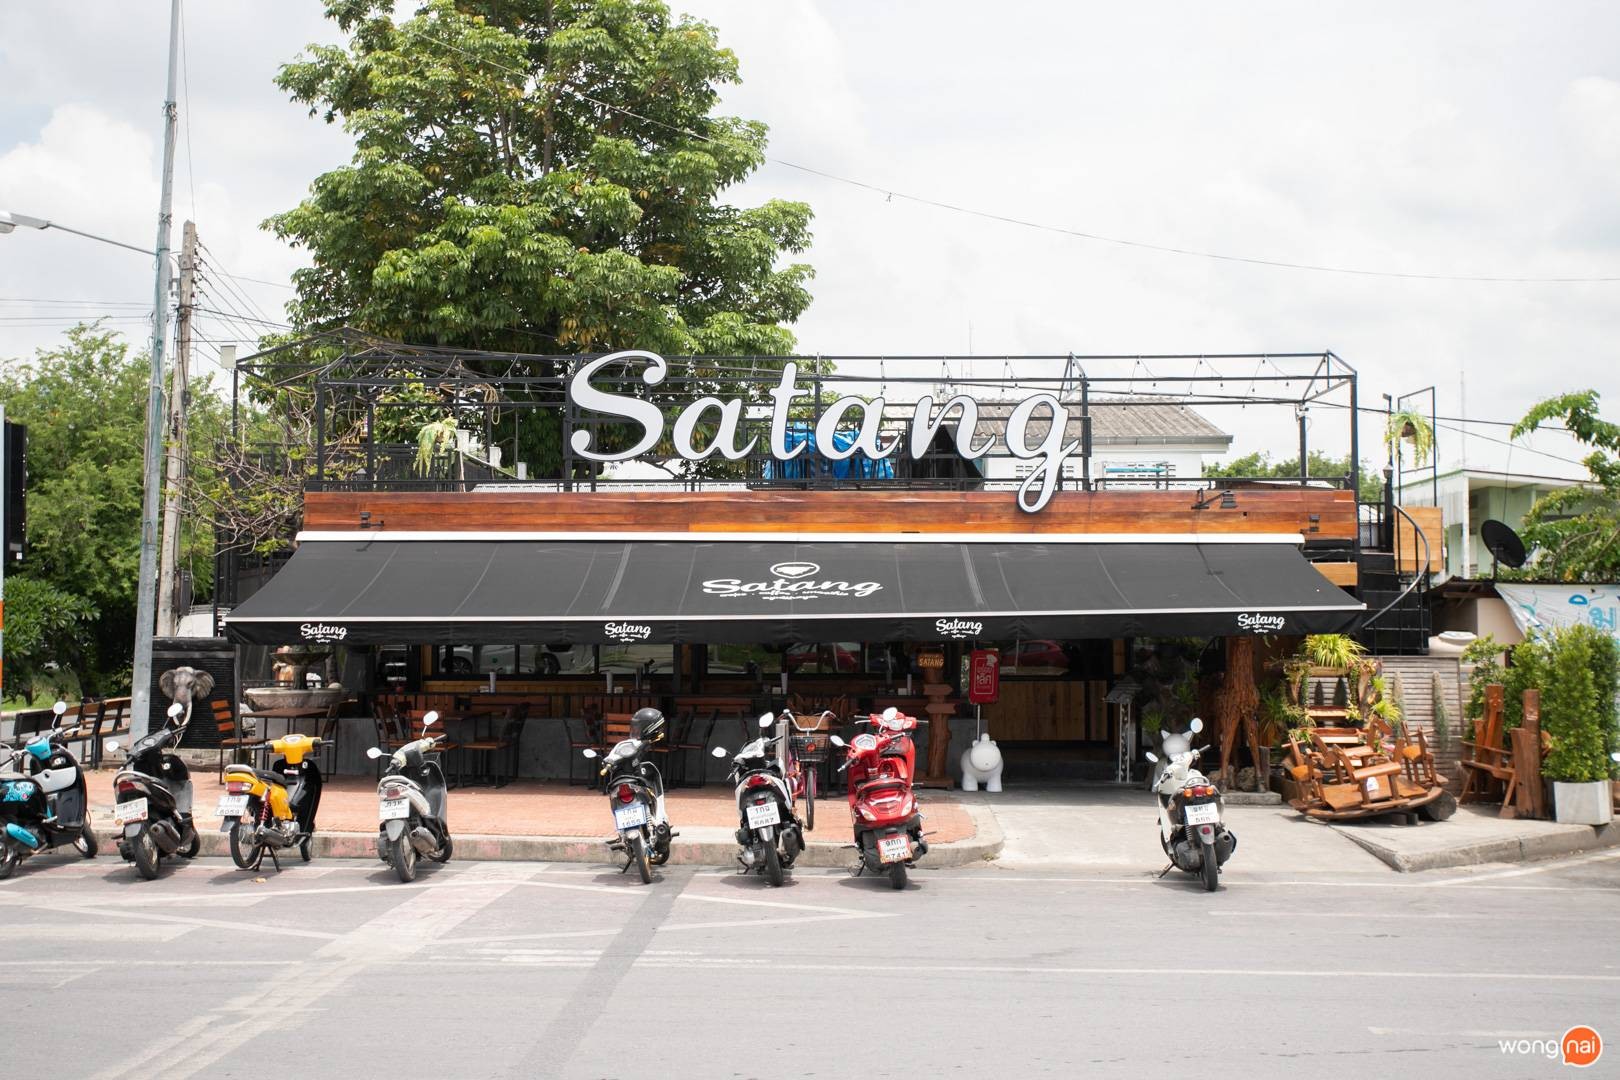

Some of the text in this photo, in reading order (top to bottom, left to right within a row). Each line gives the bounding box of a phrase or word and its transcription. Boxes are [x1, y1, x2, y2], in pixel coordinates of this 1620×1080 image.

[570, 350, 1080, 513] Satang
[702, 578, 884, 597] Satang
[604, 621, 652, 639] Satang
[935, 618, 983, 635] Satang
[1237, 613, 1286, 630] Satang
[300, 622, 348, 640] Satang
